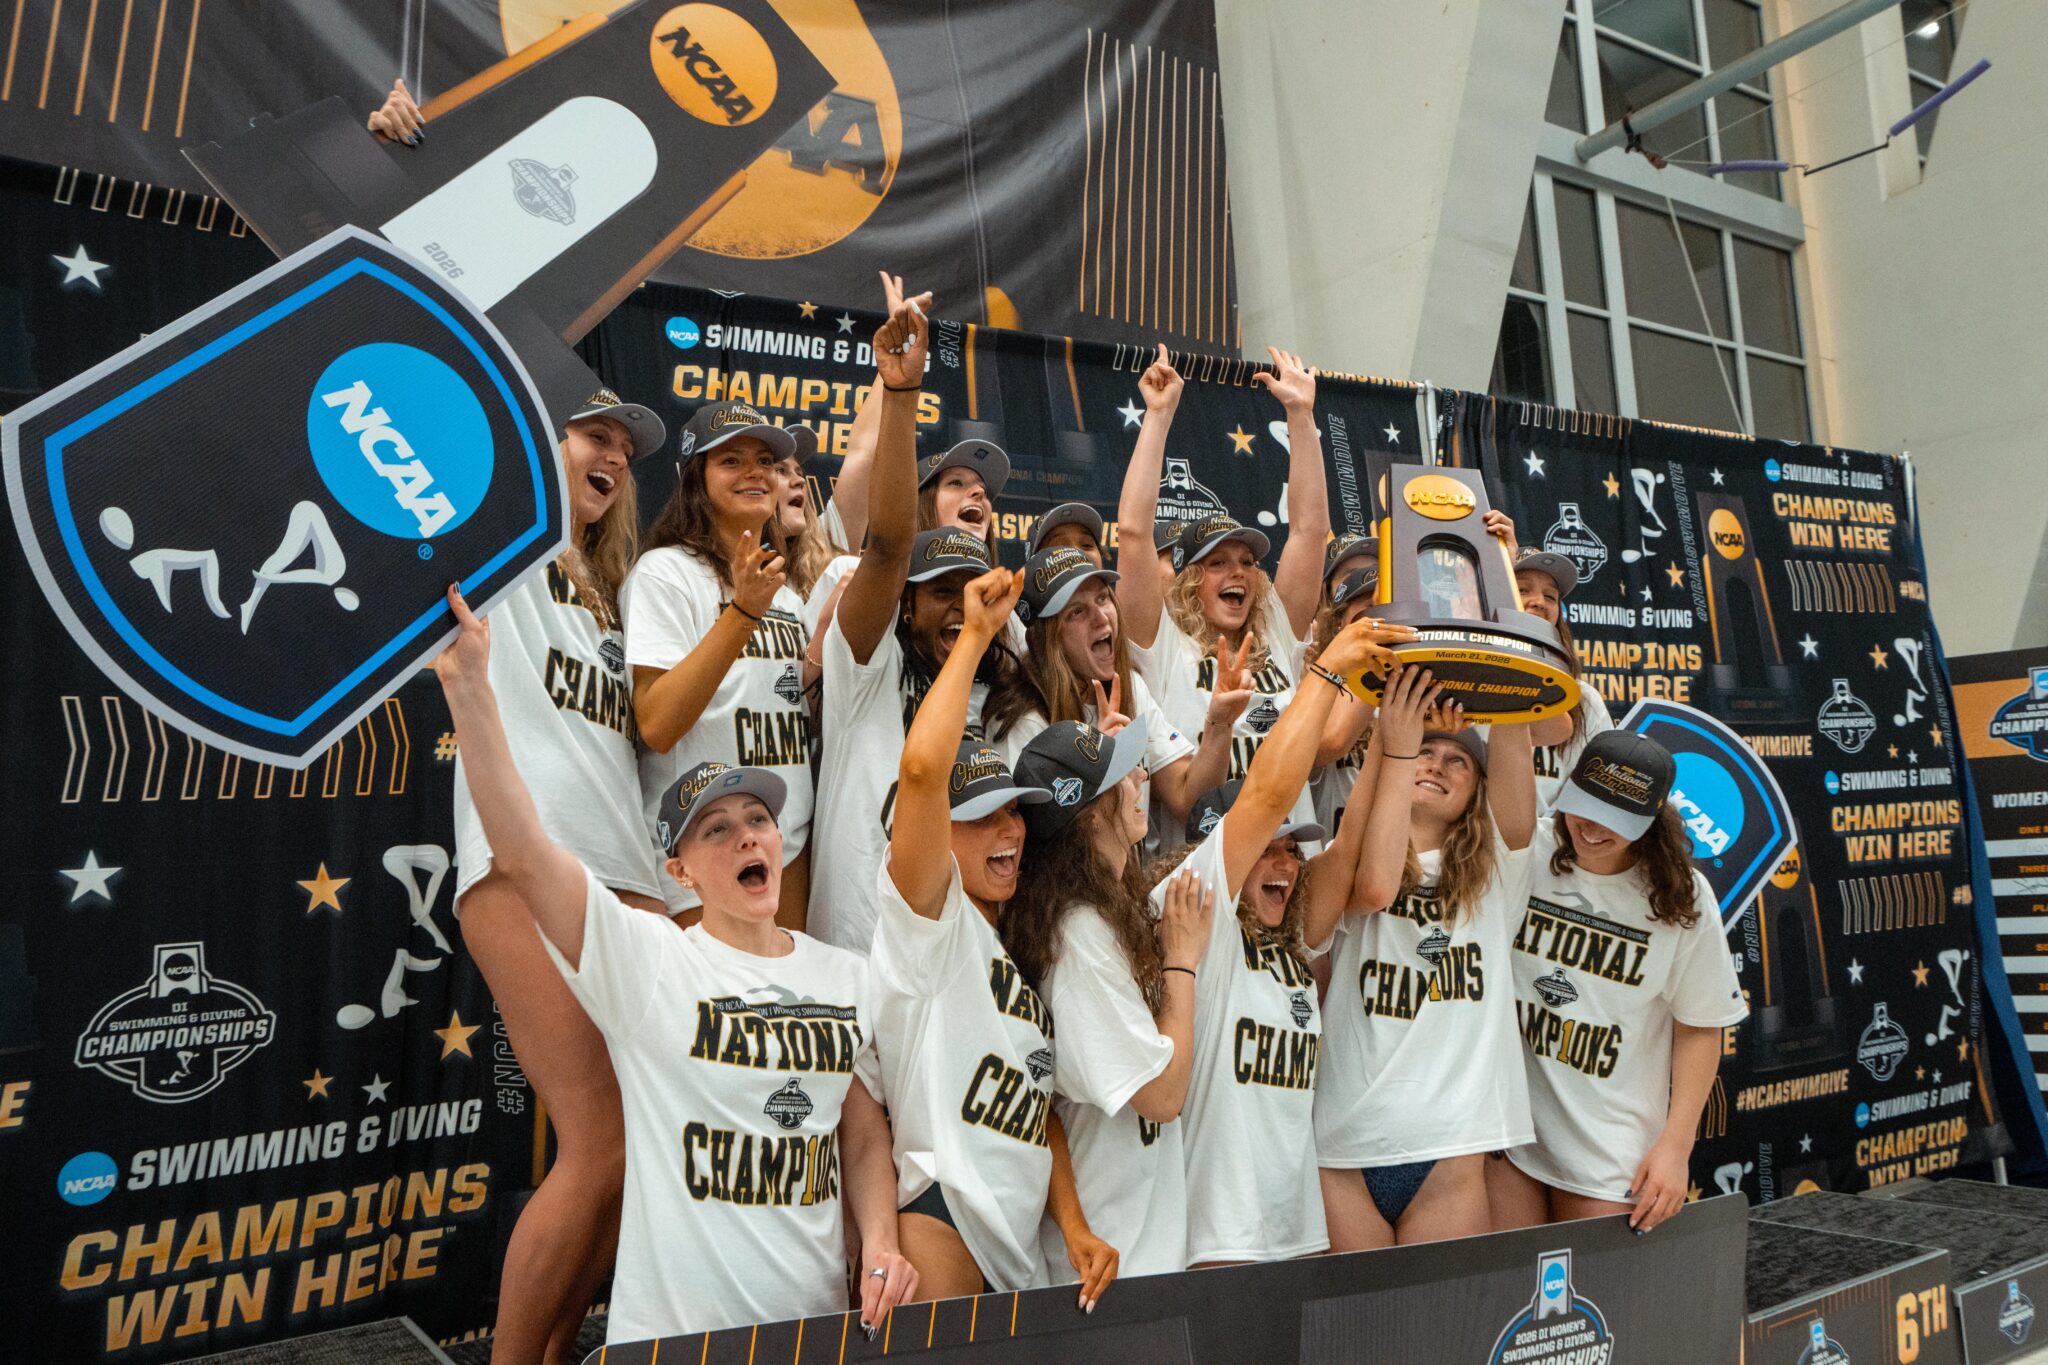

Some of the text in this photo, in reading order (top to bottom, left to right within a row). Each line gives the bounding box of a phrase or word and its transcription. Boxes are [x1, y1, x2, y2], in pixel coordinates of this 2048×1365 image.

[656, 26, 756, 125] NCAA
[422, 241, 464, 280] 2026
[669, 329, 699, 342] NCAA
[705, 324, 826, 360] SWIMMING
[833, 339, 850, 364] &
[321, 380, 457, 538] NCAA
[1782, 463, 1840, 486] SWIMMING
[1840, 472, 1849, 487] &
[1850, 471, 1884, 490] DIVING
[1411, 490, 1475, 509] NCAA
[1772, 492, 1897, 525] CHAMPIONS
[946, 534, 986, 553] National
[1714, 532, 1744, 547] NCAA
[1788, 522, 1891, 551] WIN HERE
[1045, 550, 1081, 567] National
[1546, 542, 1606, 559] CHAMPIONSHIPS
[1642, 606, 1653, 626] &
[1655, 609, 1692, 628] IVING
[1468, 632, 1532, 652] CHAMPION
[1435, 651, 1467, 659] March
[1484, 654, 1511, 663] 2026
[1477, 684, 1541, 697] CHAMPION
[1819, 717, 1876, 729] CHAMPIONSHIPS
[1604, 763, 1654, 790] National
[1841, 768, 1952, 791] SWIMMING & DIVING
[1669, 789, 1730, 856] CAA
[1832, 800, 1961, 832] CHAMPIONS
[2019, 826, 2041, 834] ONE
[1845, 830, 1952, 863] WIN HERE
[1564, 909, 1590, 924] WOMEN'S
[1513, 910, 1648, 987] ATIONAL
[167, 965, 197, 976] NCAA
[172, 1002, 188, 1013] DI
[725, 1001, 746, 1010] NCAA
[109, 1008, 246, 1032] SWIMMING & DIVING
[83, 1018, 269, 1058] CHAMPIONSHIPS
[689, 1000, 862, 1073] NATIONA
[1736, 1069, 1849, 1111] #NCAASWIMDIVE
[765, 1104, 813, 1114] CHAMPIONSHIPS
[1871, 1094, 1928, 1122] SWIMMING
[1929, 1092, 1938, 1108] &
[127, 1120, 347, 1191] SWIMMING
[356, 1115, 382, 1153] &
[64, 1174, 116, 1195] NCAA
[60, 1162, 490, 1292] CHAMPIONS
[105, 1226, 446, 1353] WIN HERE
[1545, 1278, 1565, 1291] NCAA
[1515, 1319, 1586, 1346] 2026 DI WOMEN'S
[1896, 1283, 1948, 1365] 6TH
[1503, 1331, 1596, 1365] SWIMMING & DIVING
